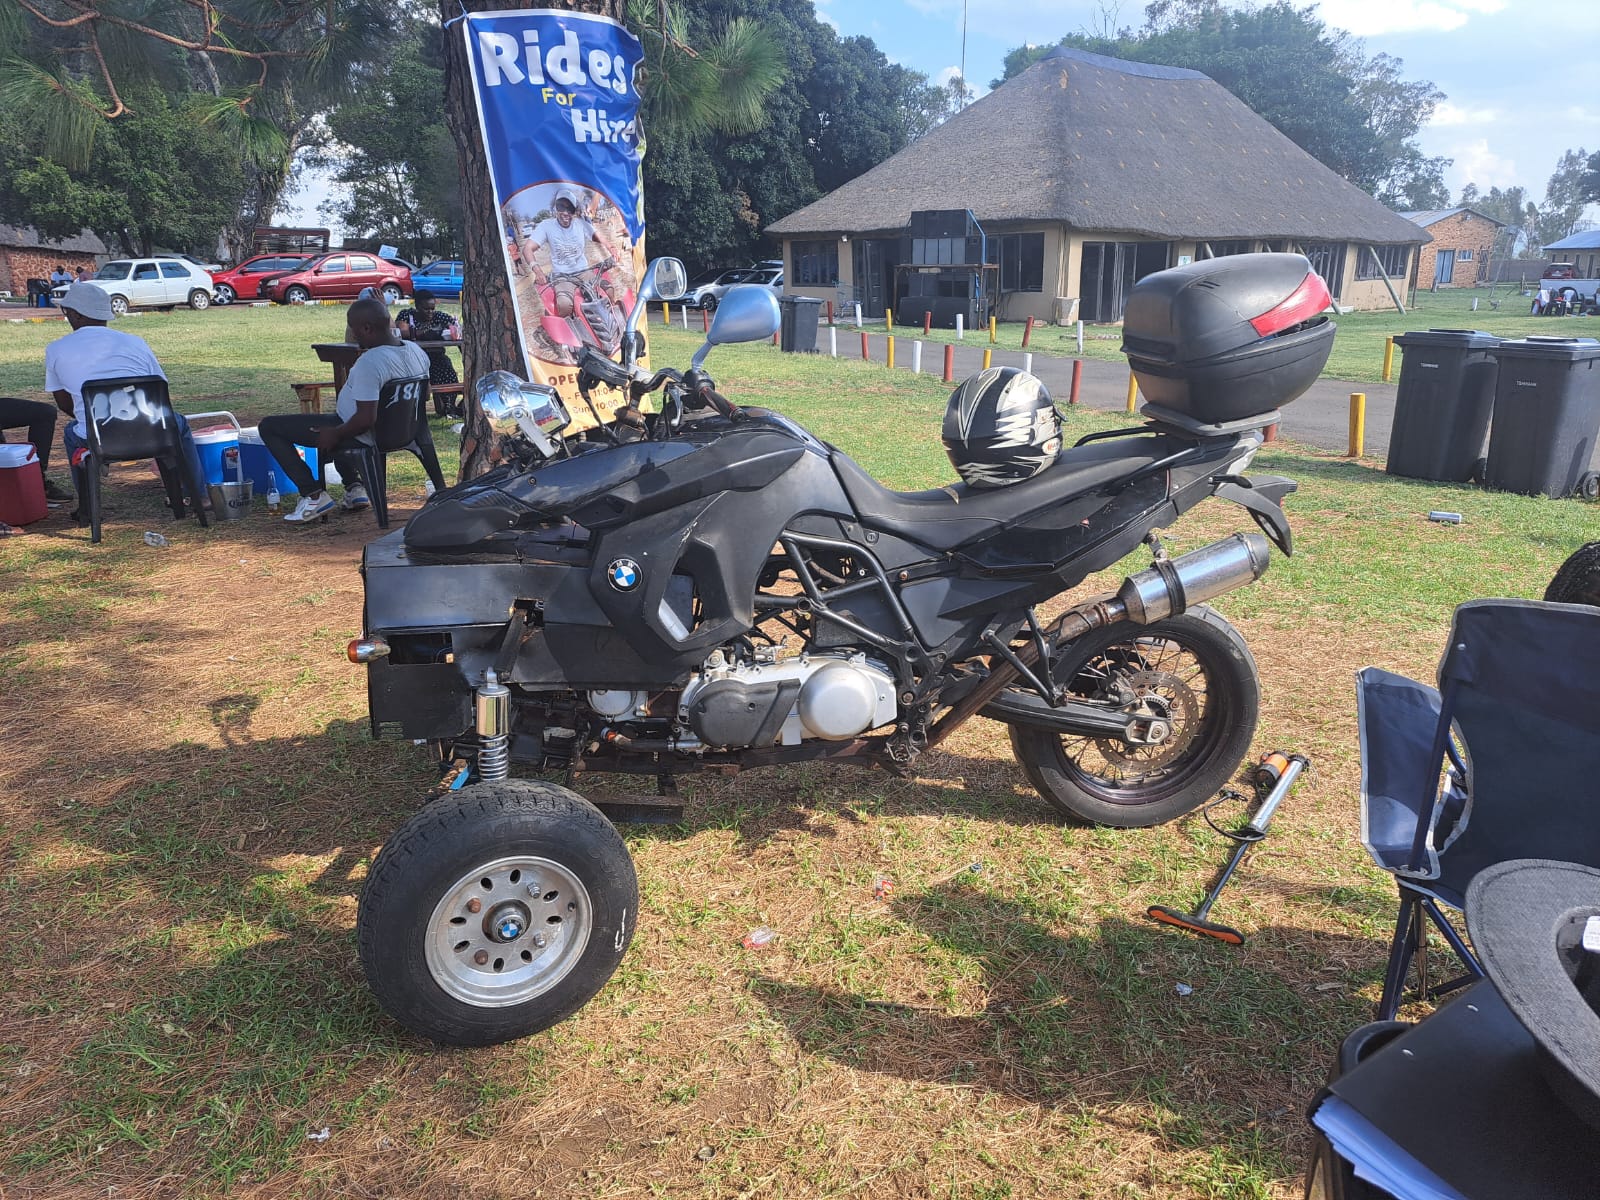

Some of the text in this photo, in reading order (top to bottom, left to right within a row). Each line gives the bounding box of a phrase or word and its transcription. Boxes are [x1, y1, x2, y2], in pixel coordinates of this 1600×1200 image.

[478, 29, 628, 95] Rides
[541, 87, 577, 106] For
[571, 108, 636, 143] Hire
[386, 381, 420, 412] 184
